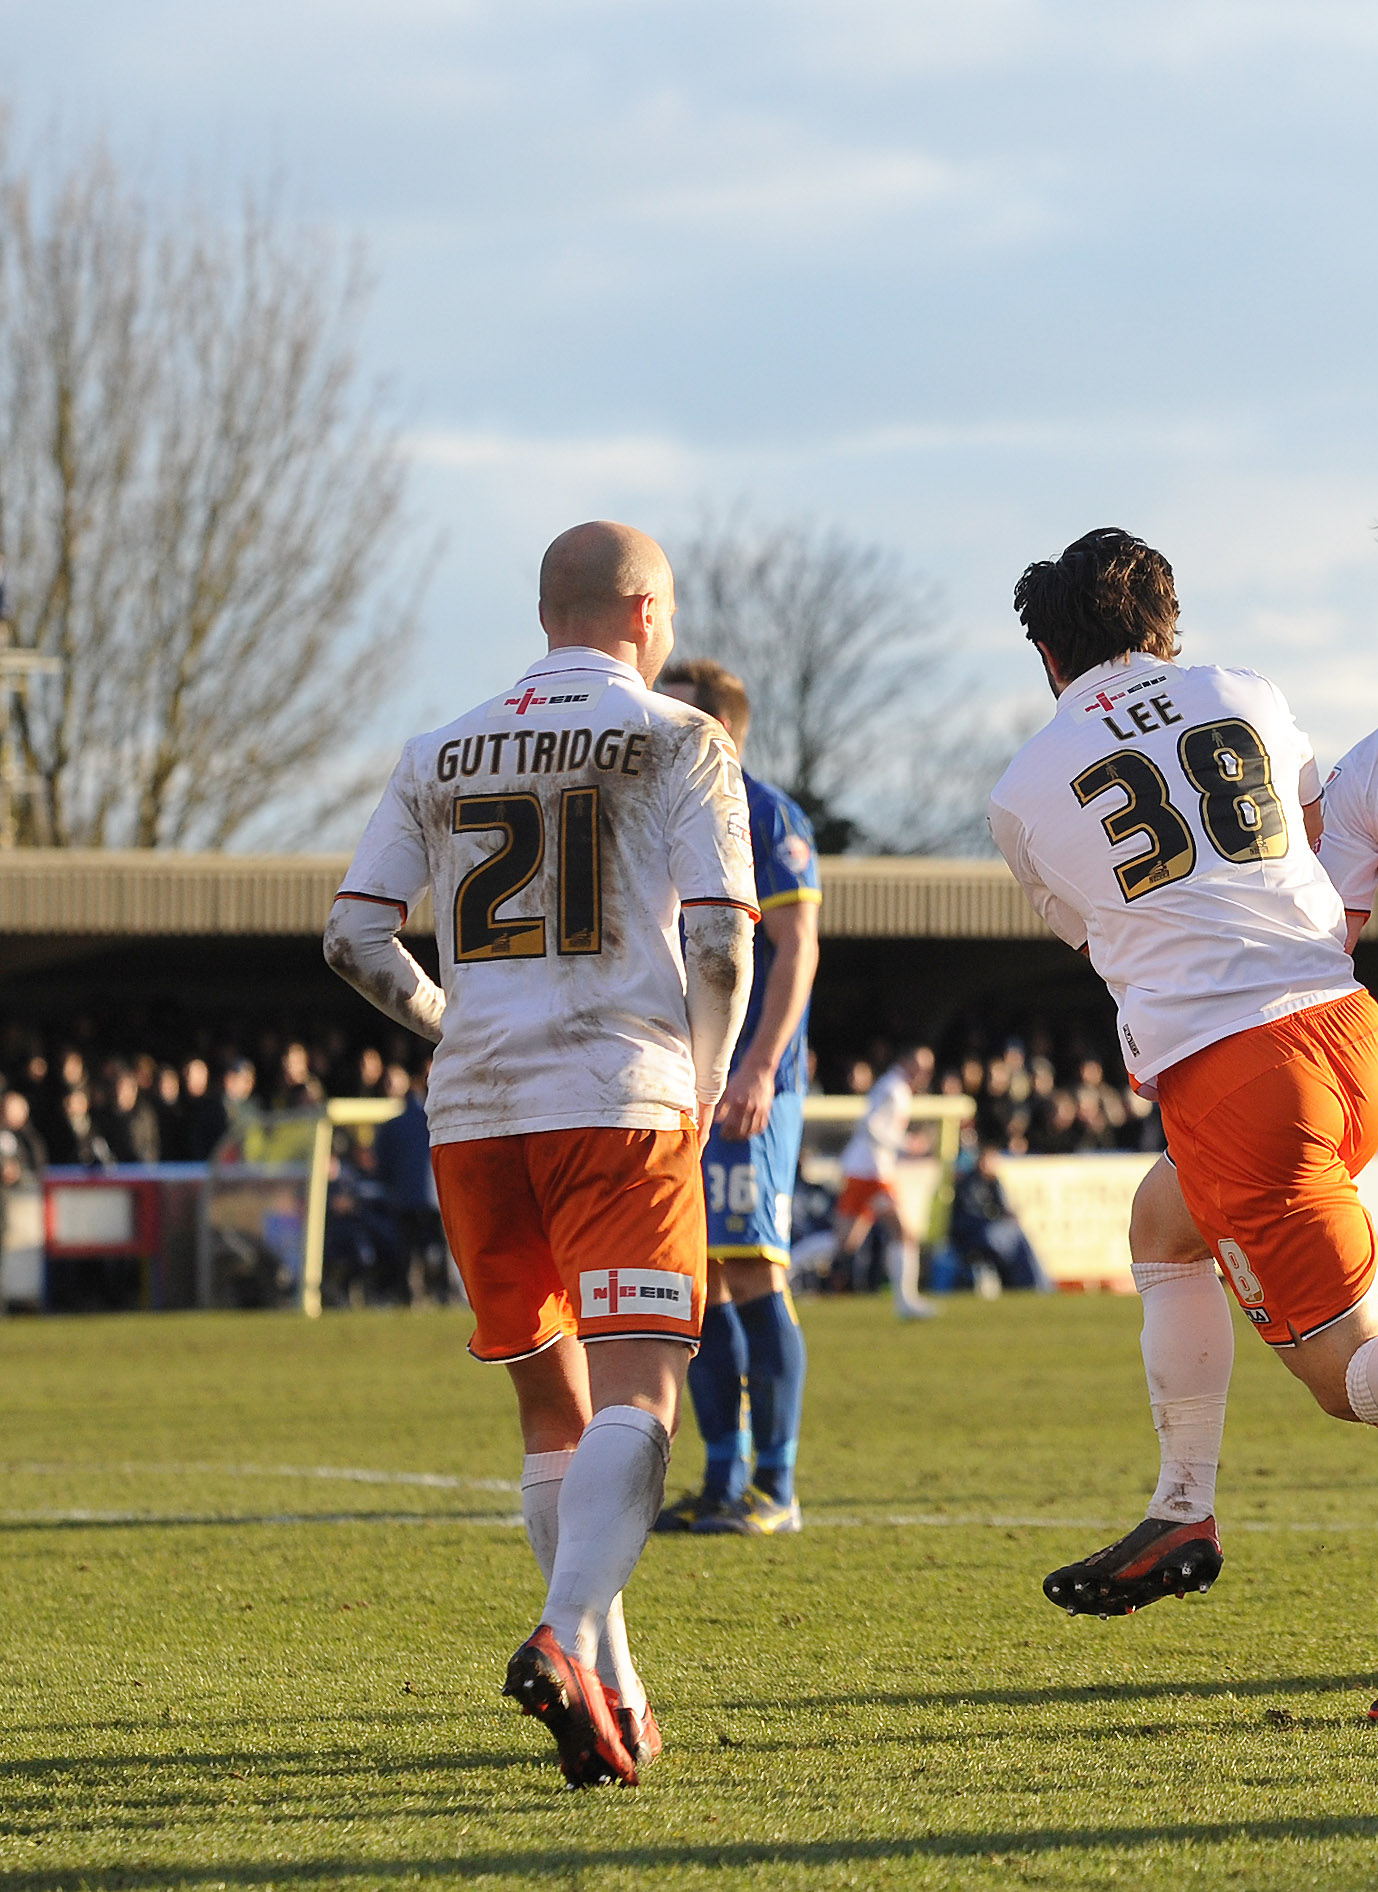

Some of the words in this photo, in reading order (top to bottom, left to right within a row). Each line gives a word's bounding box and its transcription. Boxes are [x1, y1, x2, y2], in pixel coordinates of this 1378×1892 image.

[1101, 692, 1185, 742] LEE
[436, 727, 650, 783] GUTTRIDGE
[1069, 717, 1289, 904] 38
[452, 785, 602, 964] 21
[707, 1163, 759, 1214] 36
